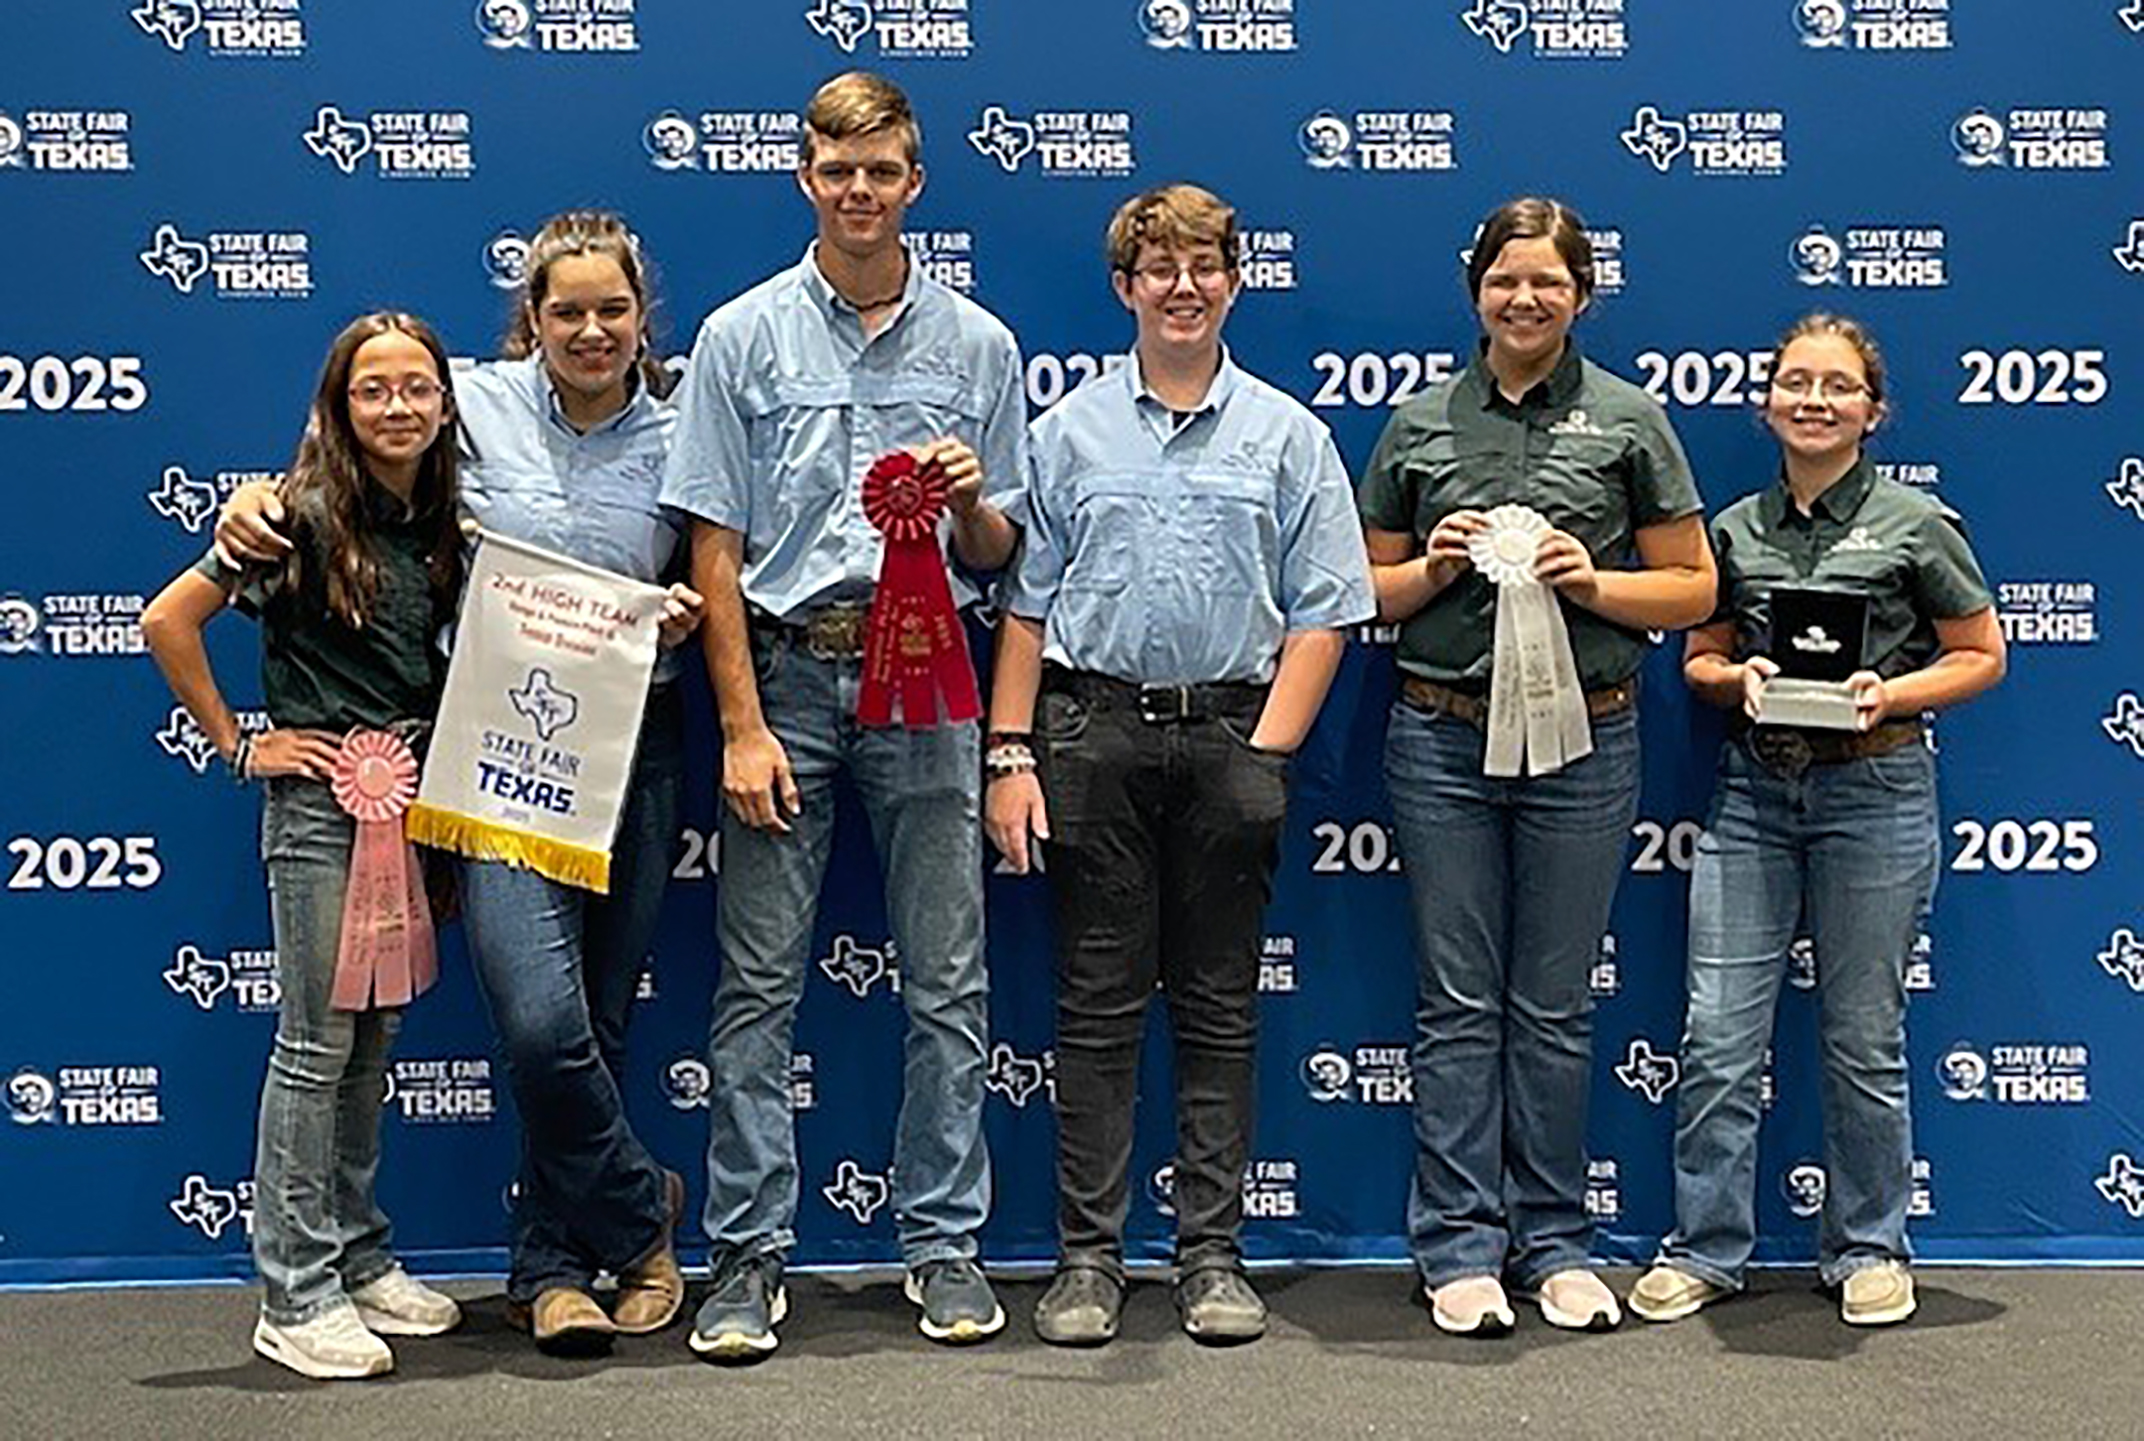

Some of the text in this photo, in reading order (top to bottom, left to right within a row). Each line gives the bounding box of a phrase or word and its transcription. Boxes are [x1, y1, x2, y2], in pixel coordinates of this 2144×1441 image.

[203, 20, 301, 47] TEXAS
[536, 23, 633, 50] TEXAS
[875, 22, 968, 48] TEXAS
[1197, 24, 1294, 50] TEXAS
[1530, 23, 1624, 48] TEXAS
[1851, 22, 1949, 48] TEXAS
[27, 112, 127, 132] STATE FAIR
[372, 114, 468, 133] STATE FAIR
[702, 114, 799, 133] STATE FAIR
[1030, 114, 1128, 133] STATE FAIR
[1357, 114, 1452, 133] STATE FAIR
[1688, 113, 1782, 132] STATE FAIR
[2010, 111, 2106, 130] STATE FAIR
[28, 142, 127, 169] TEXAS
[370, 144, 470, 169] TEXAS
[702, 144, 799, 170] TEXAS
[1030, 143, 1128, 168] TEXAS
[1356, 143, 1454, 169] TEXAS
[1685, 141, 1783, 167] TEXAS
[2009, 140, 2108, 167] TEXAS
[210, 234, 307, 252] STATE FAIR
[933, 232, 971, 250] FAIR
[1253, 232, 1293, 250] FAIR
[1847, 231, 1942, 249] STATE FAIR
[207, 262, 309, 289] TEXAS
[1846, 260, 1942, 285] TEXAS
[0, 356, 147, 411] 2025
[1959, 350, 2107, 403] 2025
[1899, 465, 1938, 483] FAIR
[44, 596, 145, 616] STATE FAIR
[531, 586, 583, 612] HIGH
[590, 601, 639, 627] TEAM
[1999, 584, 2093, 604] STATE FAIR
[45, 625, 144, 653] TEXAS
[1997, 613, 2097, 641] TEXAS
[482, 730, 581, 777] STATE FAIR
[478, 761, 574, 813] TEXAS
[1951, 820, 2097, 871] 2025
[8, 837, 161, 888] 2025
[1993, 1047, 2086, 1067] STATE FAIR
[60, 1068, 157, 1087] STATE FAIR
[395, 1061, 489, 1081] STATE FAIR
[1993, 1076, 2089, 1101] TEXAS
[61, 1096, 158, 1124] TEXAS
[395, 1090, 492, 1115] TEXAS
